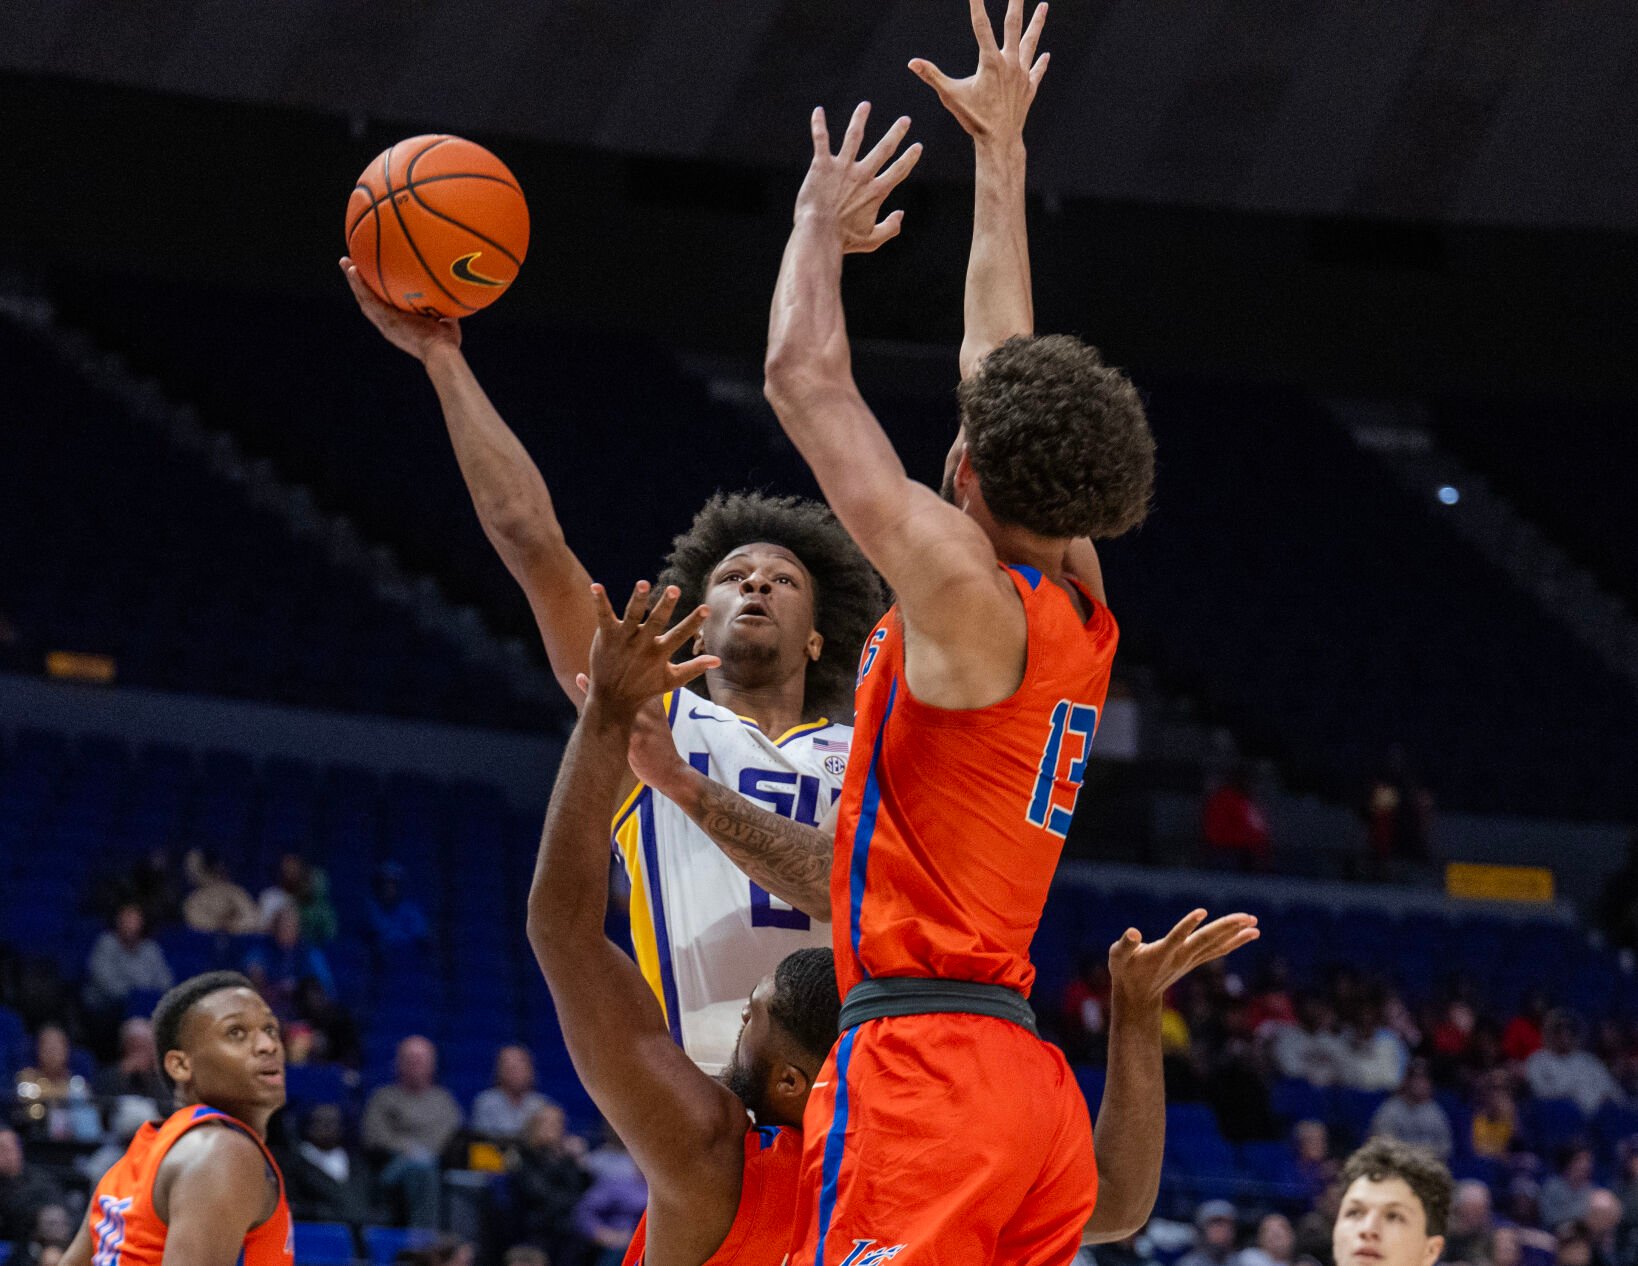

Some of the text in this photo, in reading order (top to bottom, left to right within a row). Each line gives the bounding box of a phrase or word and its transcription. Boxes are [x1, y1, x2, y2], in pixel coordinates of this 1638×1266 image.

[689, 752, 842, 828] SU
[825, 756, 846, 775] SEC
[1025, 698, 1098, 839] 13
[714, 815, 775, 851] OVER
